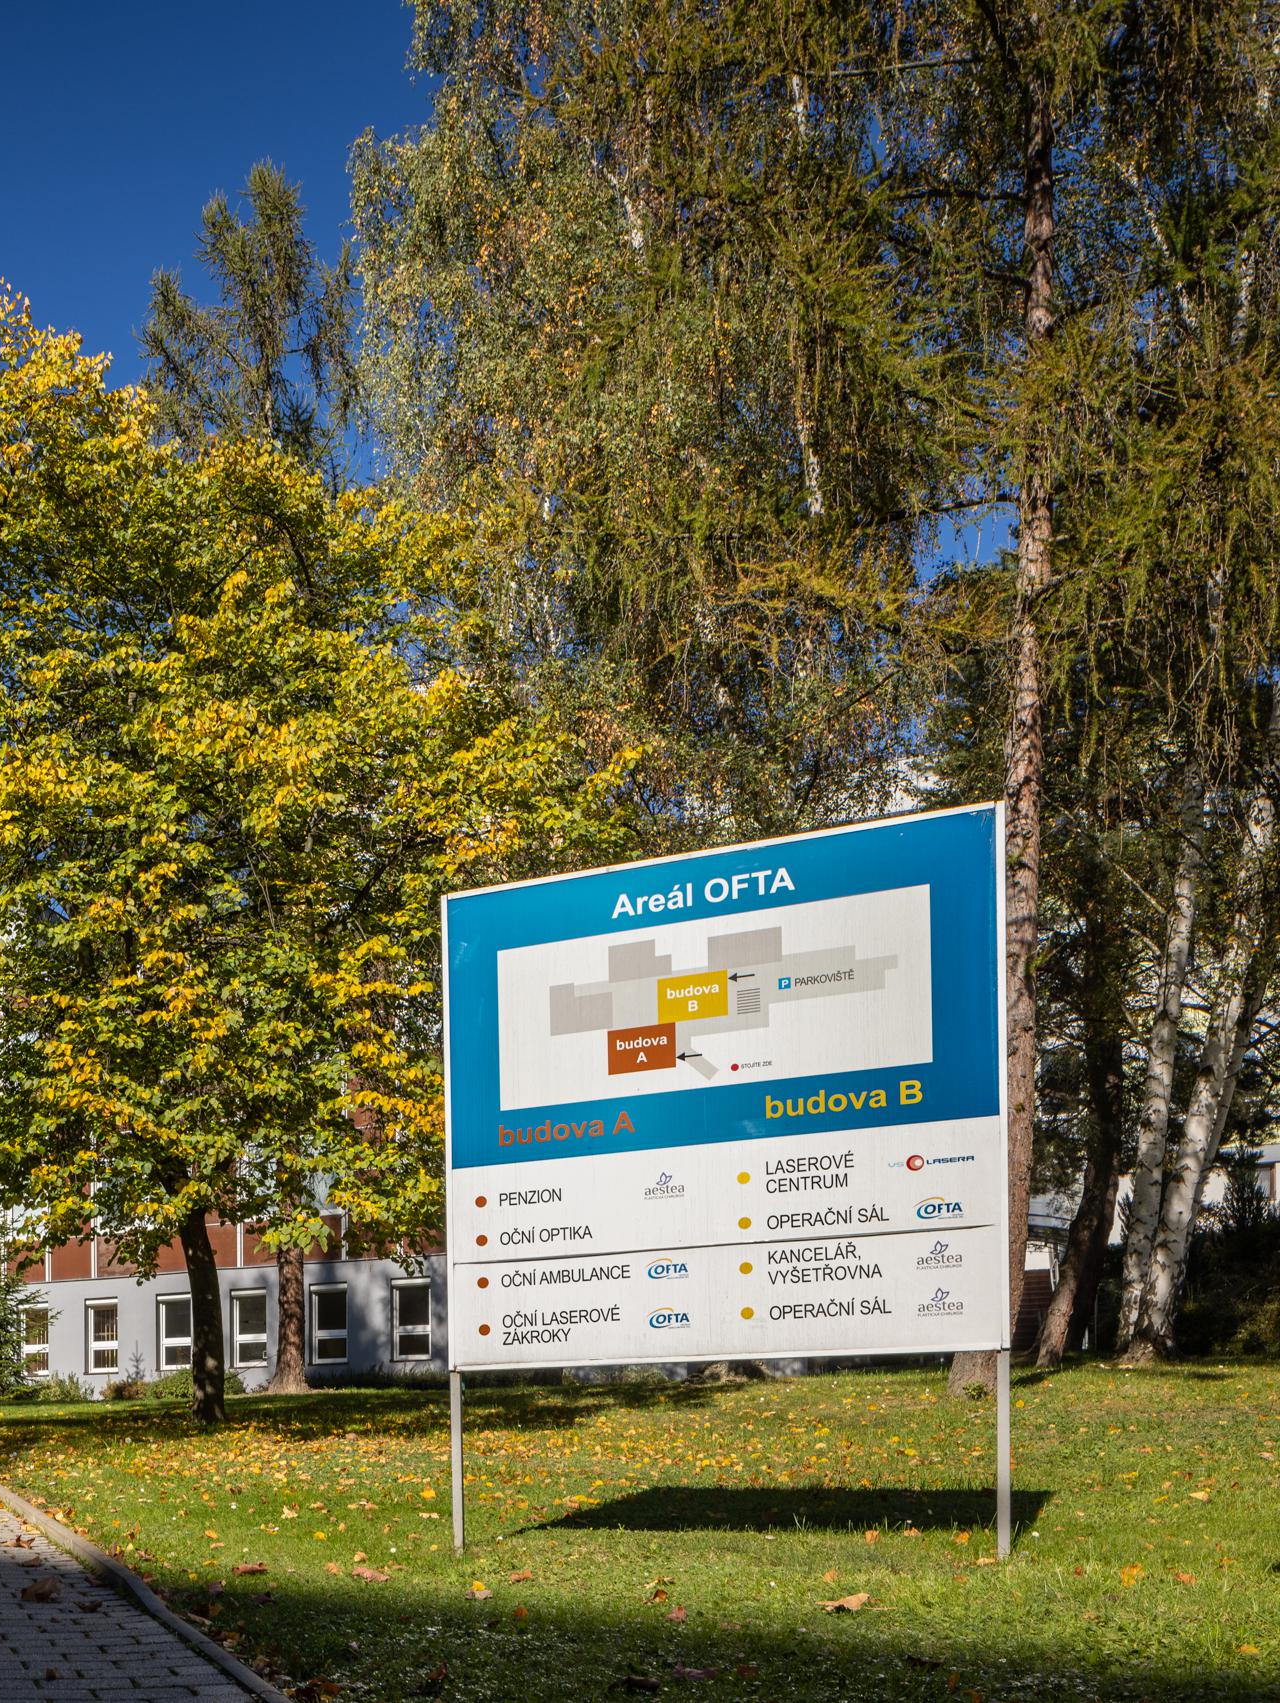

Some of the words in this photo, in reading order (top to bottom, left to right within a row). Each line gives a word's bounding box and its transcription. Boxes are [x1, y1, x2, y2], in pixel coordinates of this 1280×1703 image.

[612, 882, 693, 919] Areál
[704, 867, 795, 903] OFTA
[781, 980, 789, 988] P
[794, 968, 854, 987] PARKOVIŠTĚ
[666, 983, 719, 999] budova
[687, 1000, 698, 1012] B
[616, 1035, 667, 1051] budova
[636, 1051, 647, 1063] A
[765, 1088, 887, 1120] budova
[899, 1079, 923, 1106] B
[498, 1119, 604, 1147] budova
[613, 1110, 635, 1135] A
[765, 1150, 854, 1175] LASEROVÉ
[926, 1155, 975, 1165] LASERA
[644, 1184, 685, 1196] aestea
[766, 1173, 848, 1194] CENTRUM
[499, 1188, 562, 1207] PENZION
[767, 1205, 852, 1230] OPERAČNÍ
[857, 1203, 889, 1223] SÁL
[924, 1202, 963, 1215] OFTA
[500, 1226, 535, 1246] OČNÍ
[539, 1225, 593, 1243] OPTIKA
[768, 1241, 861, 1265] KANCELÁŘ,
[916, 1253, 963, 1266] aestea
[501, 1268, 536, 1288] OČNÍ
[539, 1264, 631, 1285] AMBULANCE
[654, 1263, 689, 1275] OFTA
[768, 1263, 882, 1285] VYŠETŘOVNA
[769, 1297, 855, 1321] OPERAČNÍ
[860, 1296, 892, 1315] SÁL
[917, 1300, 964, 1313] aestea
[502, 1309, 538, 1329] OČNÍ
[541, 1304, 620, 1326] LASEROVÉ
[655, 1312, 690, 1325] OFTA
[502, 1327, 571, 1346] ZÁKROKY
